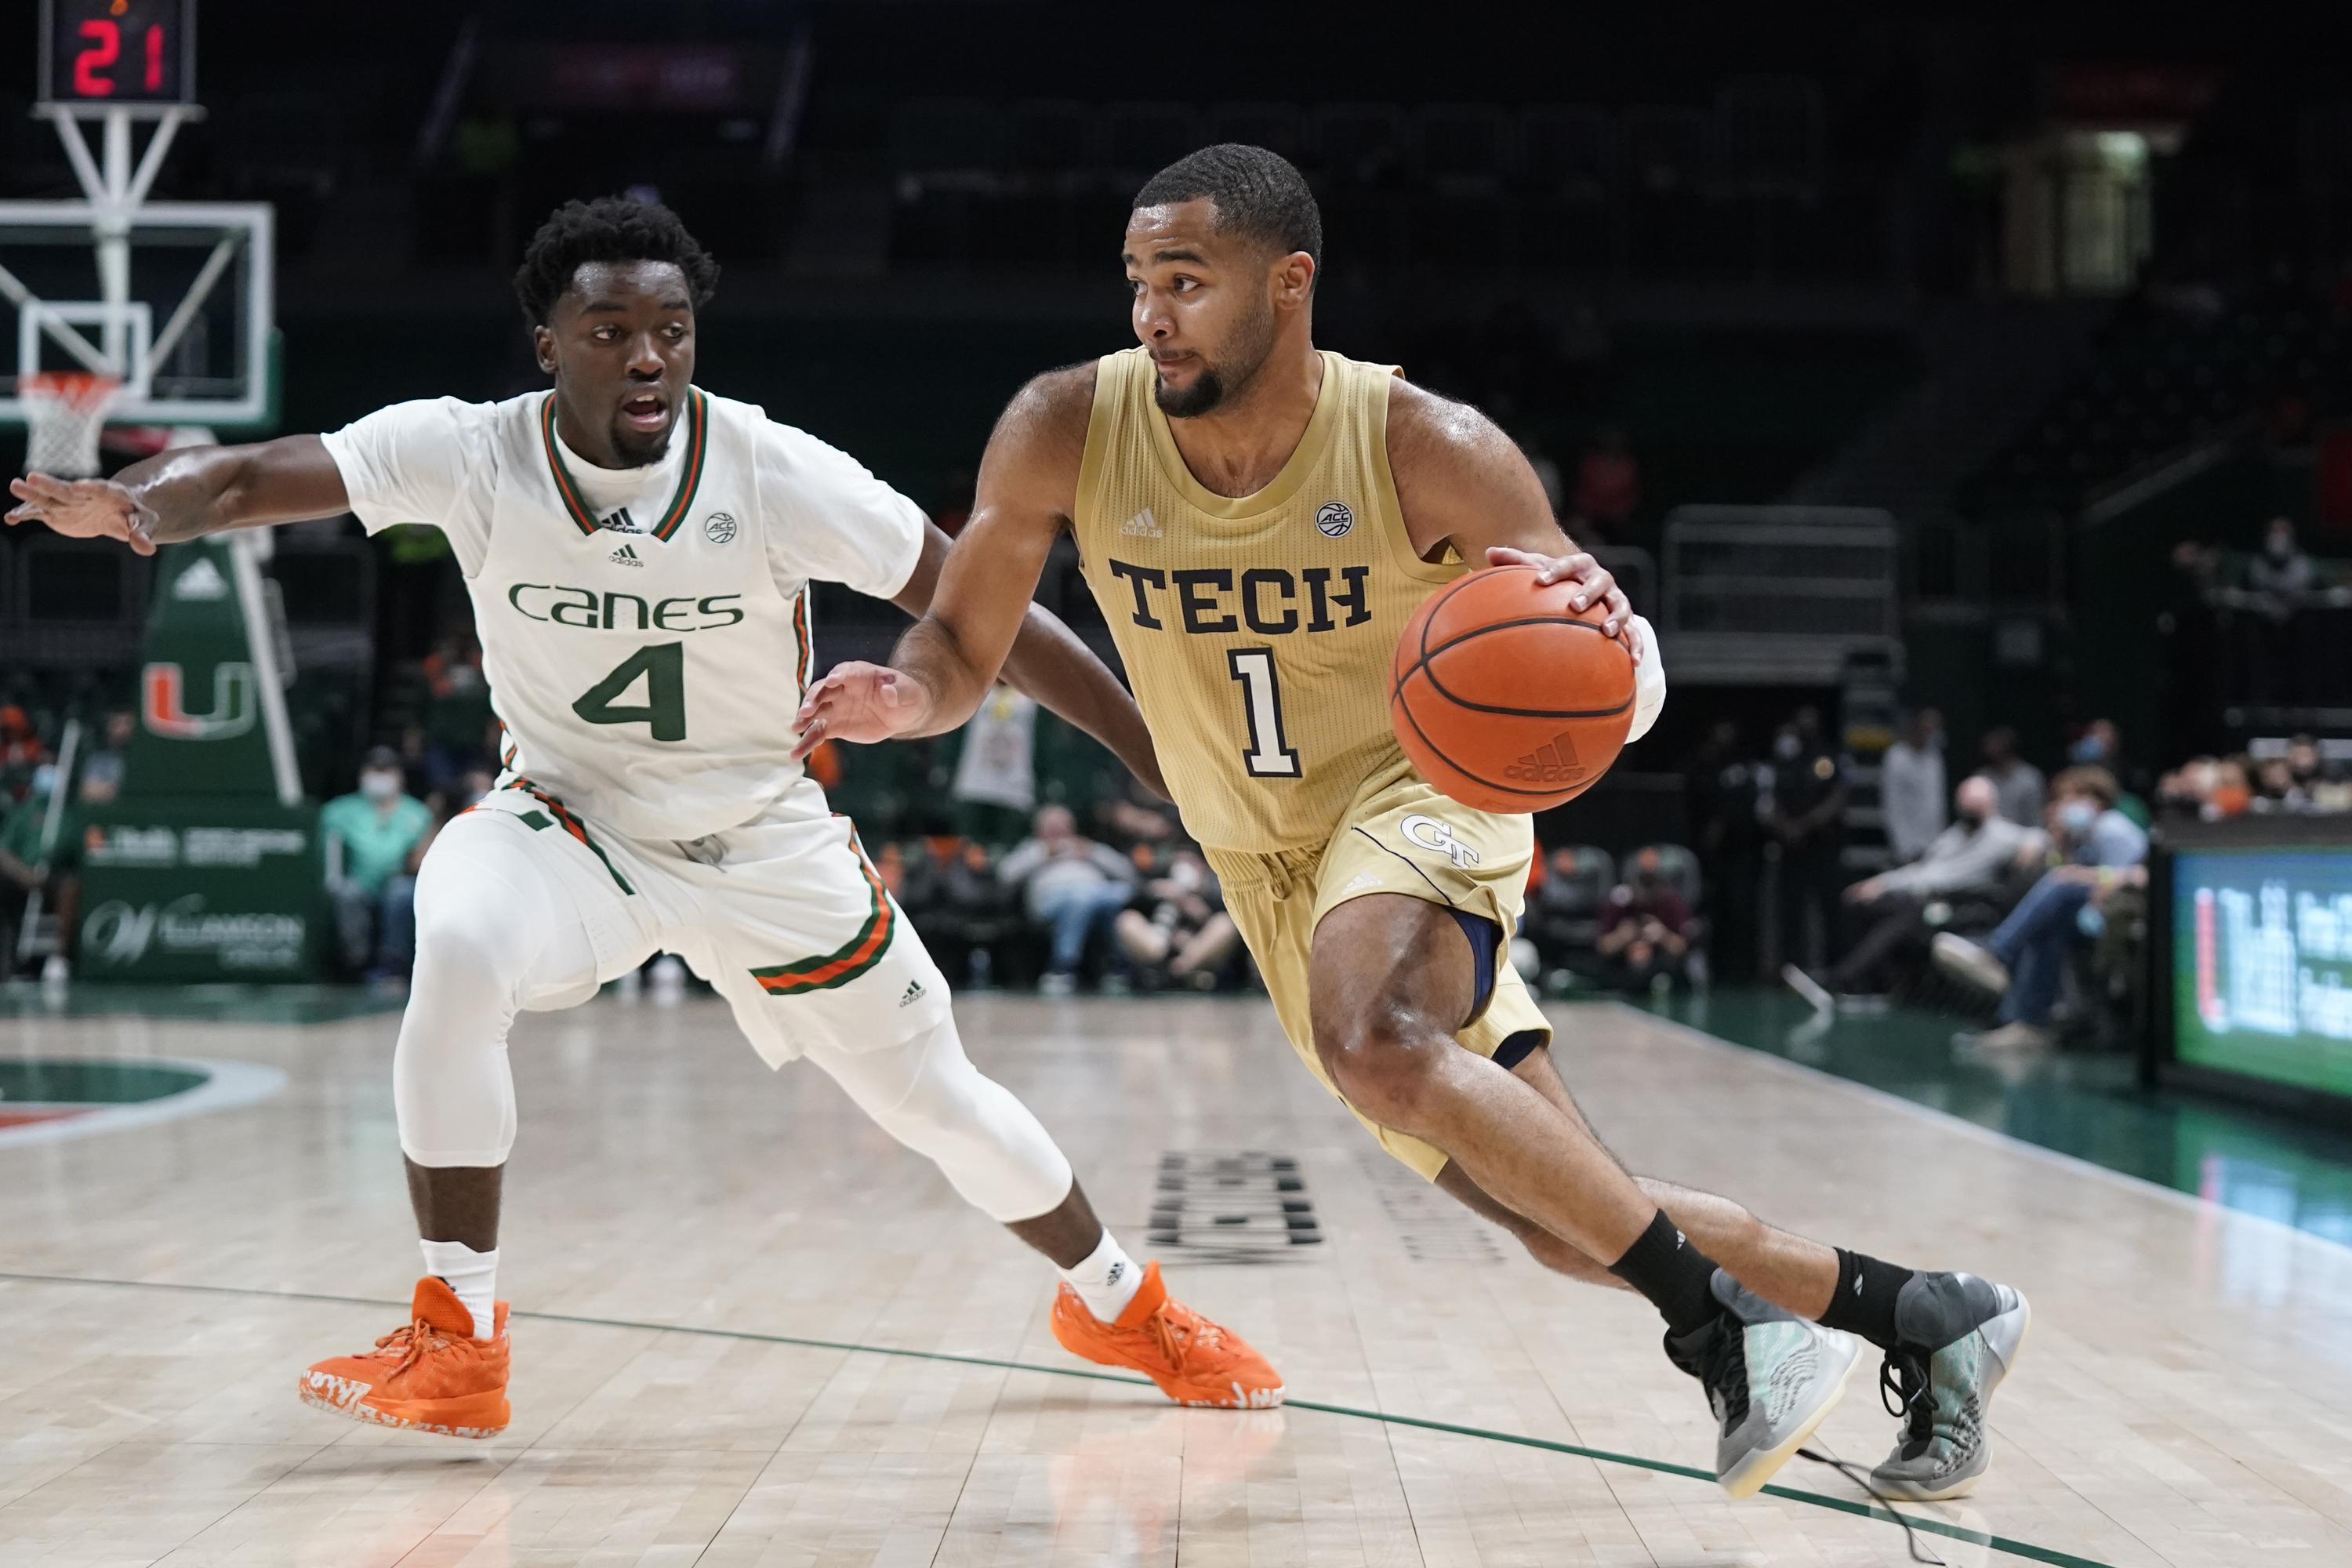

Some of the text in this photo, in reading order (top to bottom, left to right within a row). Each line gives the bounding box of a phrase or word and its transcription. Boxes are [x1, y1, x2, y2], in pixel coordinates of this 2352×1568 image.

[73, 19, 164, 97] 21
[709, 521, 735, 531] ACC
[1120, 524, 1163, 539] adidas
[1320, 511, 1349, 523] ACC
[608, 554, 644, 568] adidas
[1109, 558, 1372, 635] TECH
[141, 662, 256, 742] U
[572, 641, 687, 742] 4
[1227, 647, 1303, 778] 1
[1504, 763, 1586, 782] adidas
[1400, 814, 1479, 869] GT
[898, 988, 927, 1008] adidas
